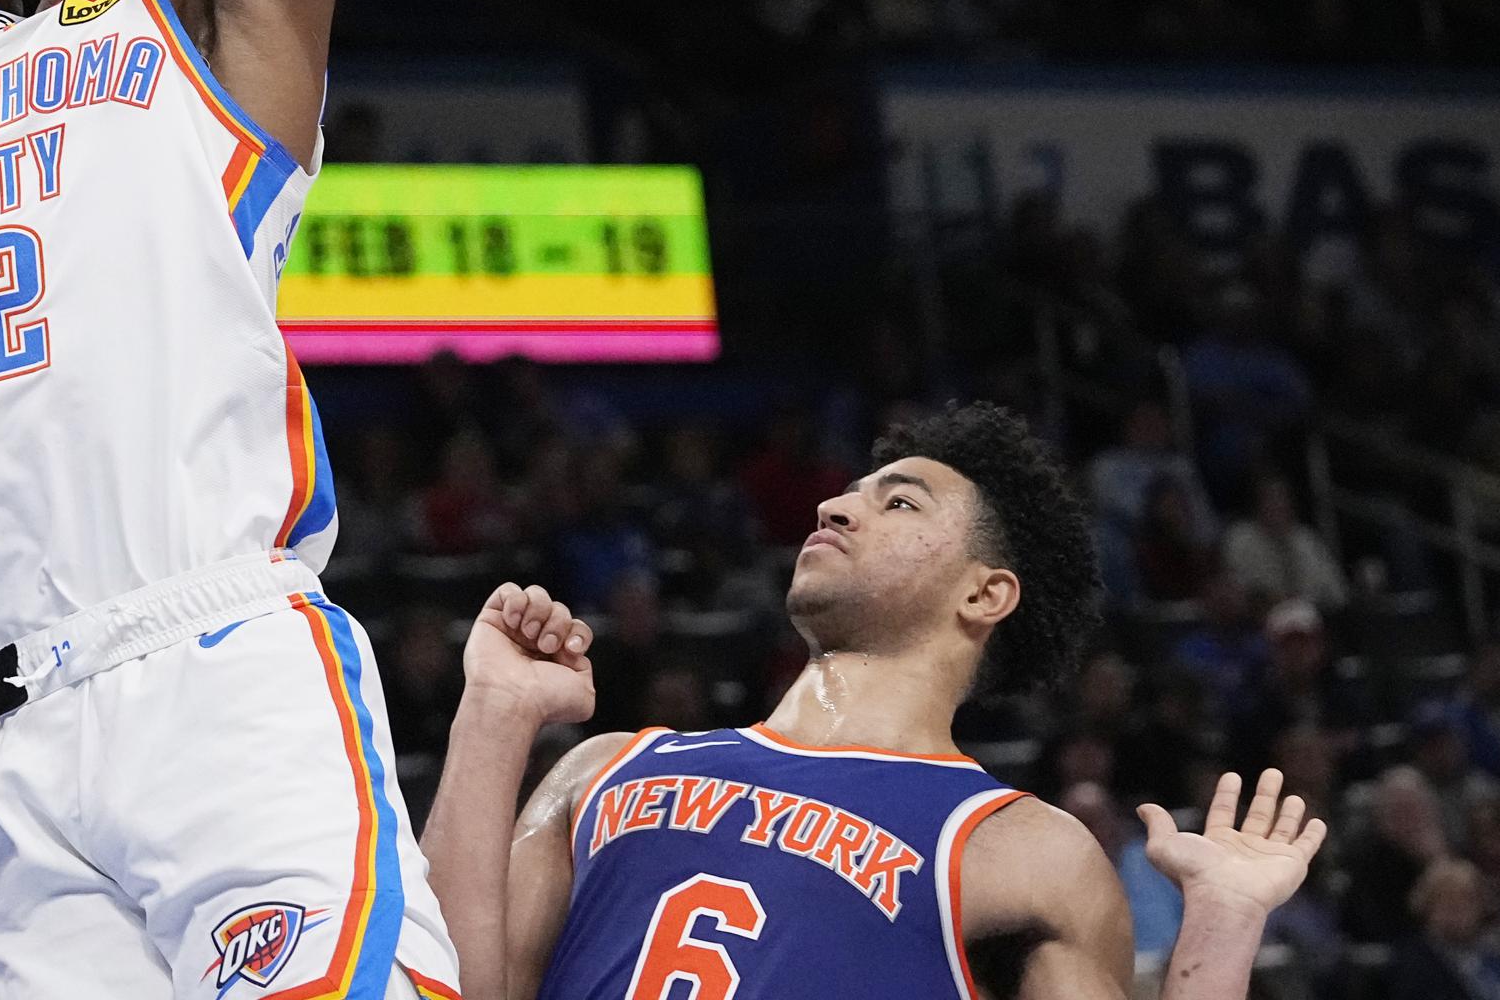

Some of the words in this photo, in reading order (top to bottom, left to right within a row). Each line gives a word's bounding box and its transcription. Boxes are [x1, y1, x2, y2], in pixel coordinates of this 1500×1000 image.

[305, 217, 416, 278] FEB
[598, 217, 670, 278] 19
[588, 775, 750, 859] NEW
[740, 785, 925, 923] YORK
[216, 912, 283, 990] OKC
